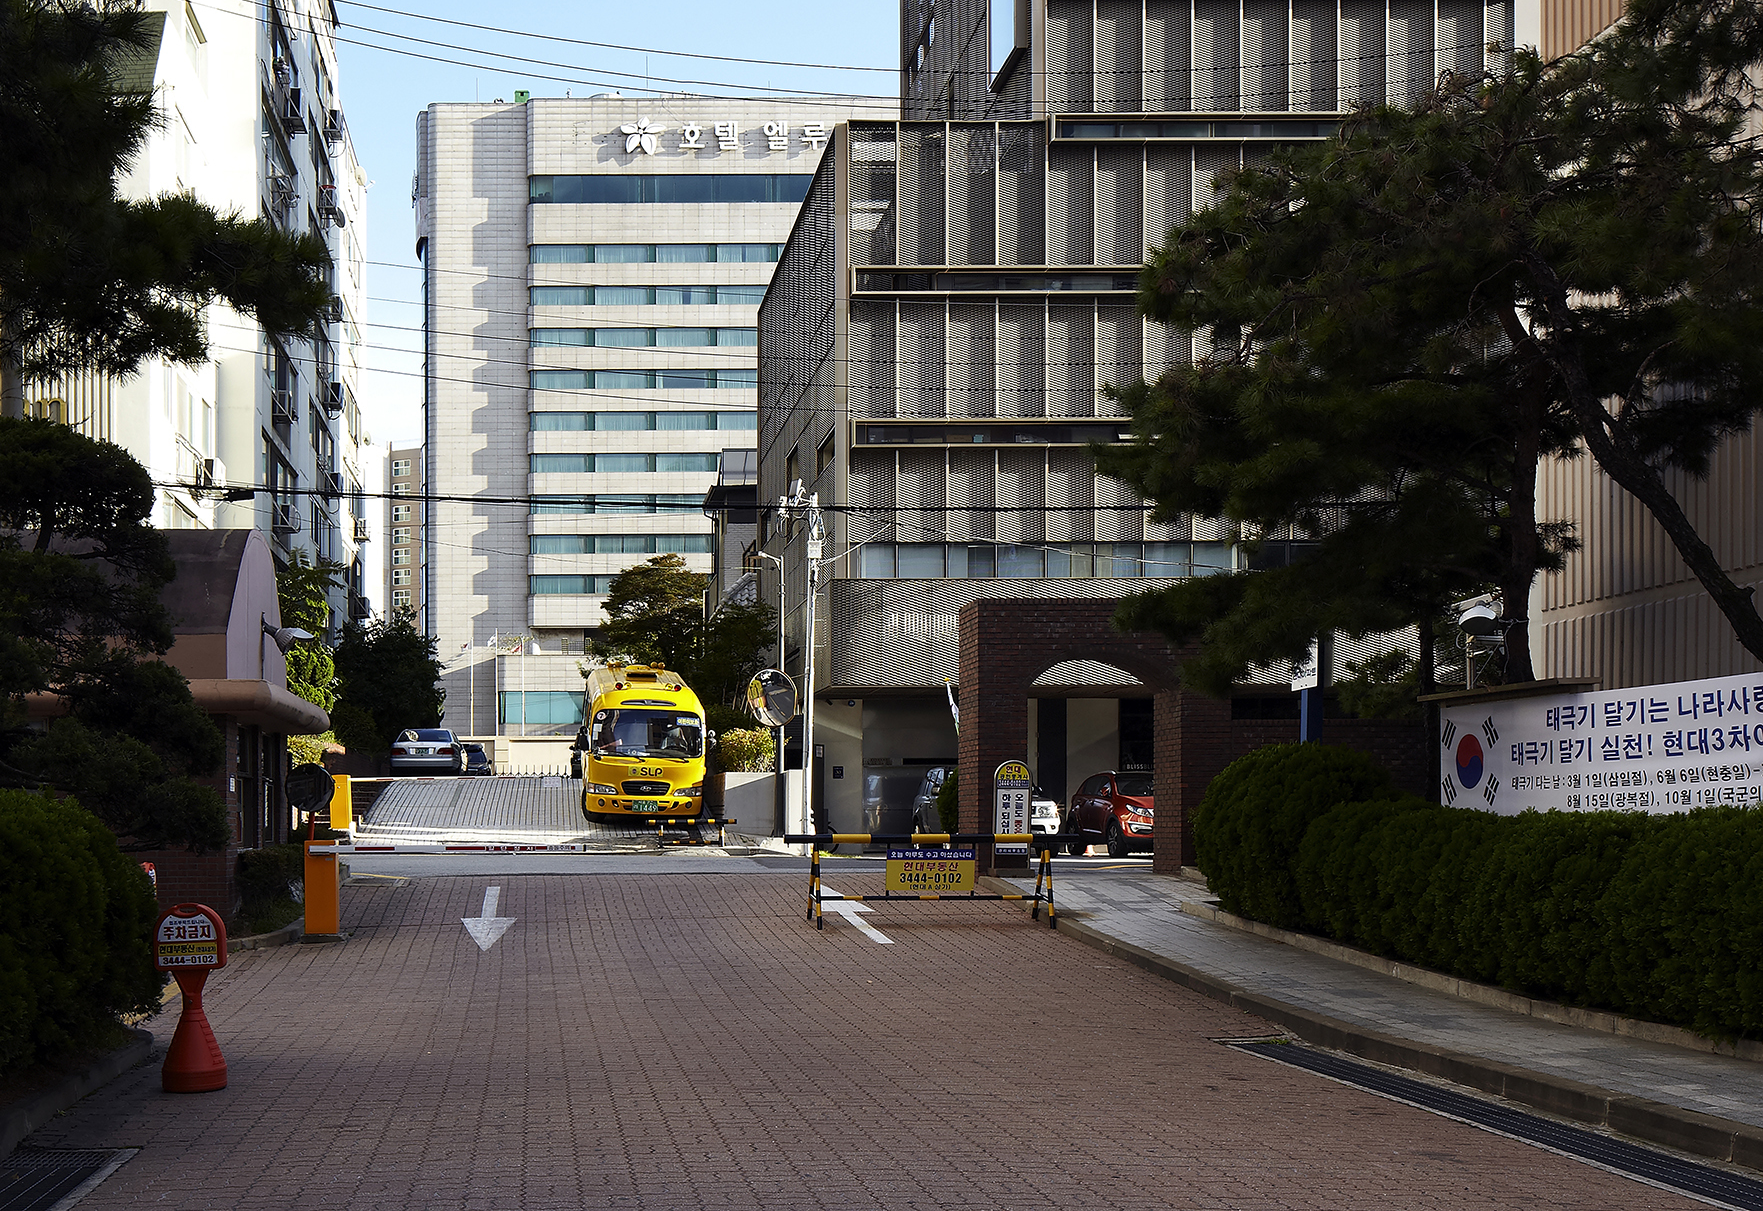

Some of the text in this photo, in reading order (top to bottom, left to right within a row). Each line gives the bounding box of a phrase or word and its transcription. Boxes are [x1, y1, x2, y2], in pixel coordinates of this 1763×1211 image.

[679, 121, 828, 150] 호텔 엘루
[1546, 703, 1595, 731] 태극기
[1604, 697, 1669, 727] 달기는
[1511, 739, 1554, 766] 태극기
[1559, 736, 1592, 764] 달기
[1600, 733, 1653, 763] 실천!
[640, 766, 663, 777] SLP
[1511, 776, 1534, 790] 태극기
[1535, 775, 1551, 789] 다는
[1656, 769, 1676, 785] 6월
[1001, 793, 1012, 810] 하루
[1014, 793, 1024, 818] 오늘도
[1566, 793, 1581, 808] 8월
[1665, 790, 1692, 805] 10월
[904, 862, 959, 872] 현대부동산
[899, 873, 962, 884] 3444-0102
[163, 925, 211, 940] 주차금지
[159, 944, 195, 954] 현대부동산
[162, 955, 214, 965] 3444-0102
